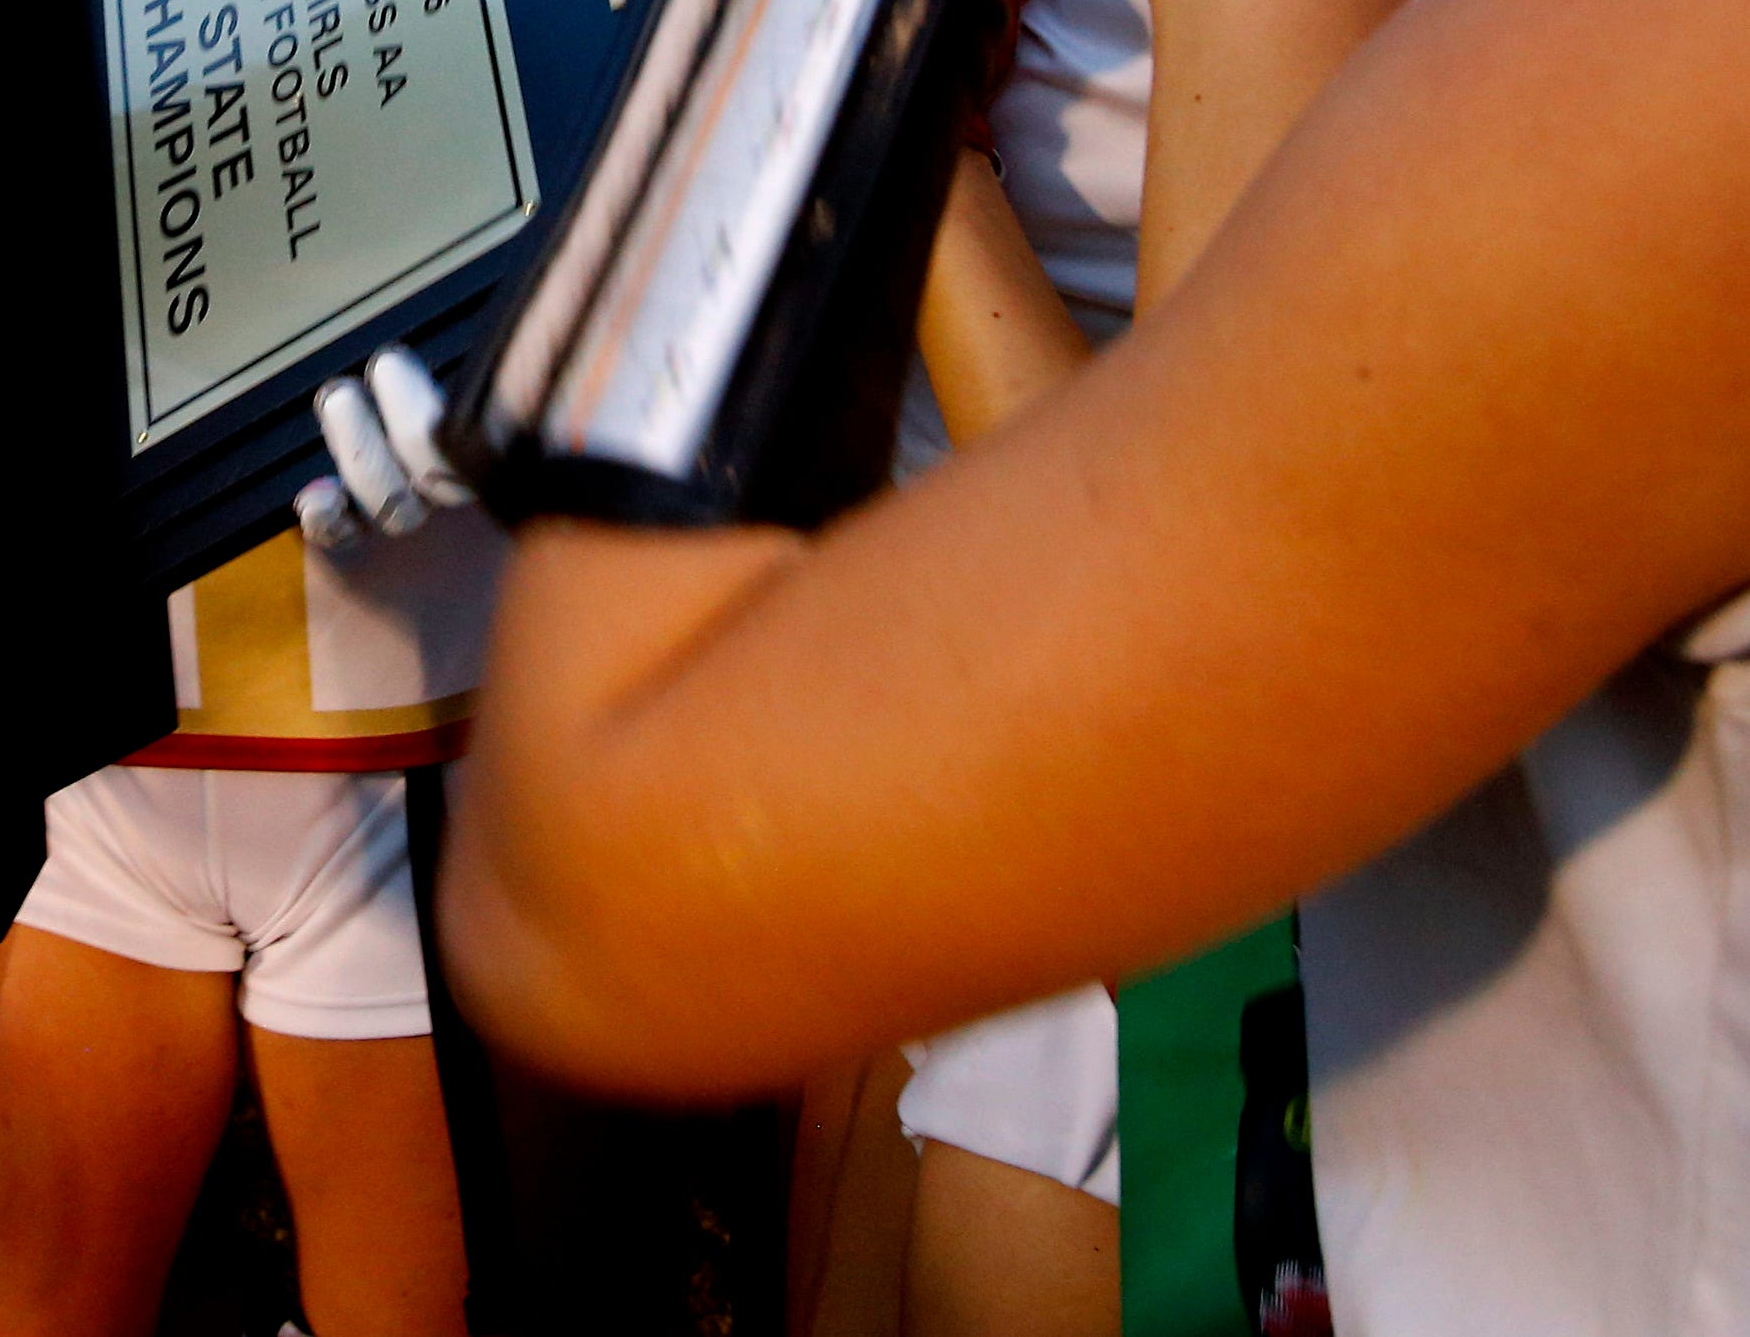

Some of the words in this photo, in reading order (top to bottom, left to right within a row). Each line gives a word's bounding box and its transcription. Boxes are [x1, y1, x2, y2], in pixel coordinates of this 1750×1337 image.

[199, 4, 254, 200] STATE
[263, 1, 321, 262] FOOTBALL
[372, 43, 408, 108] AA
